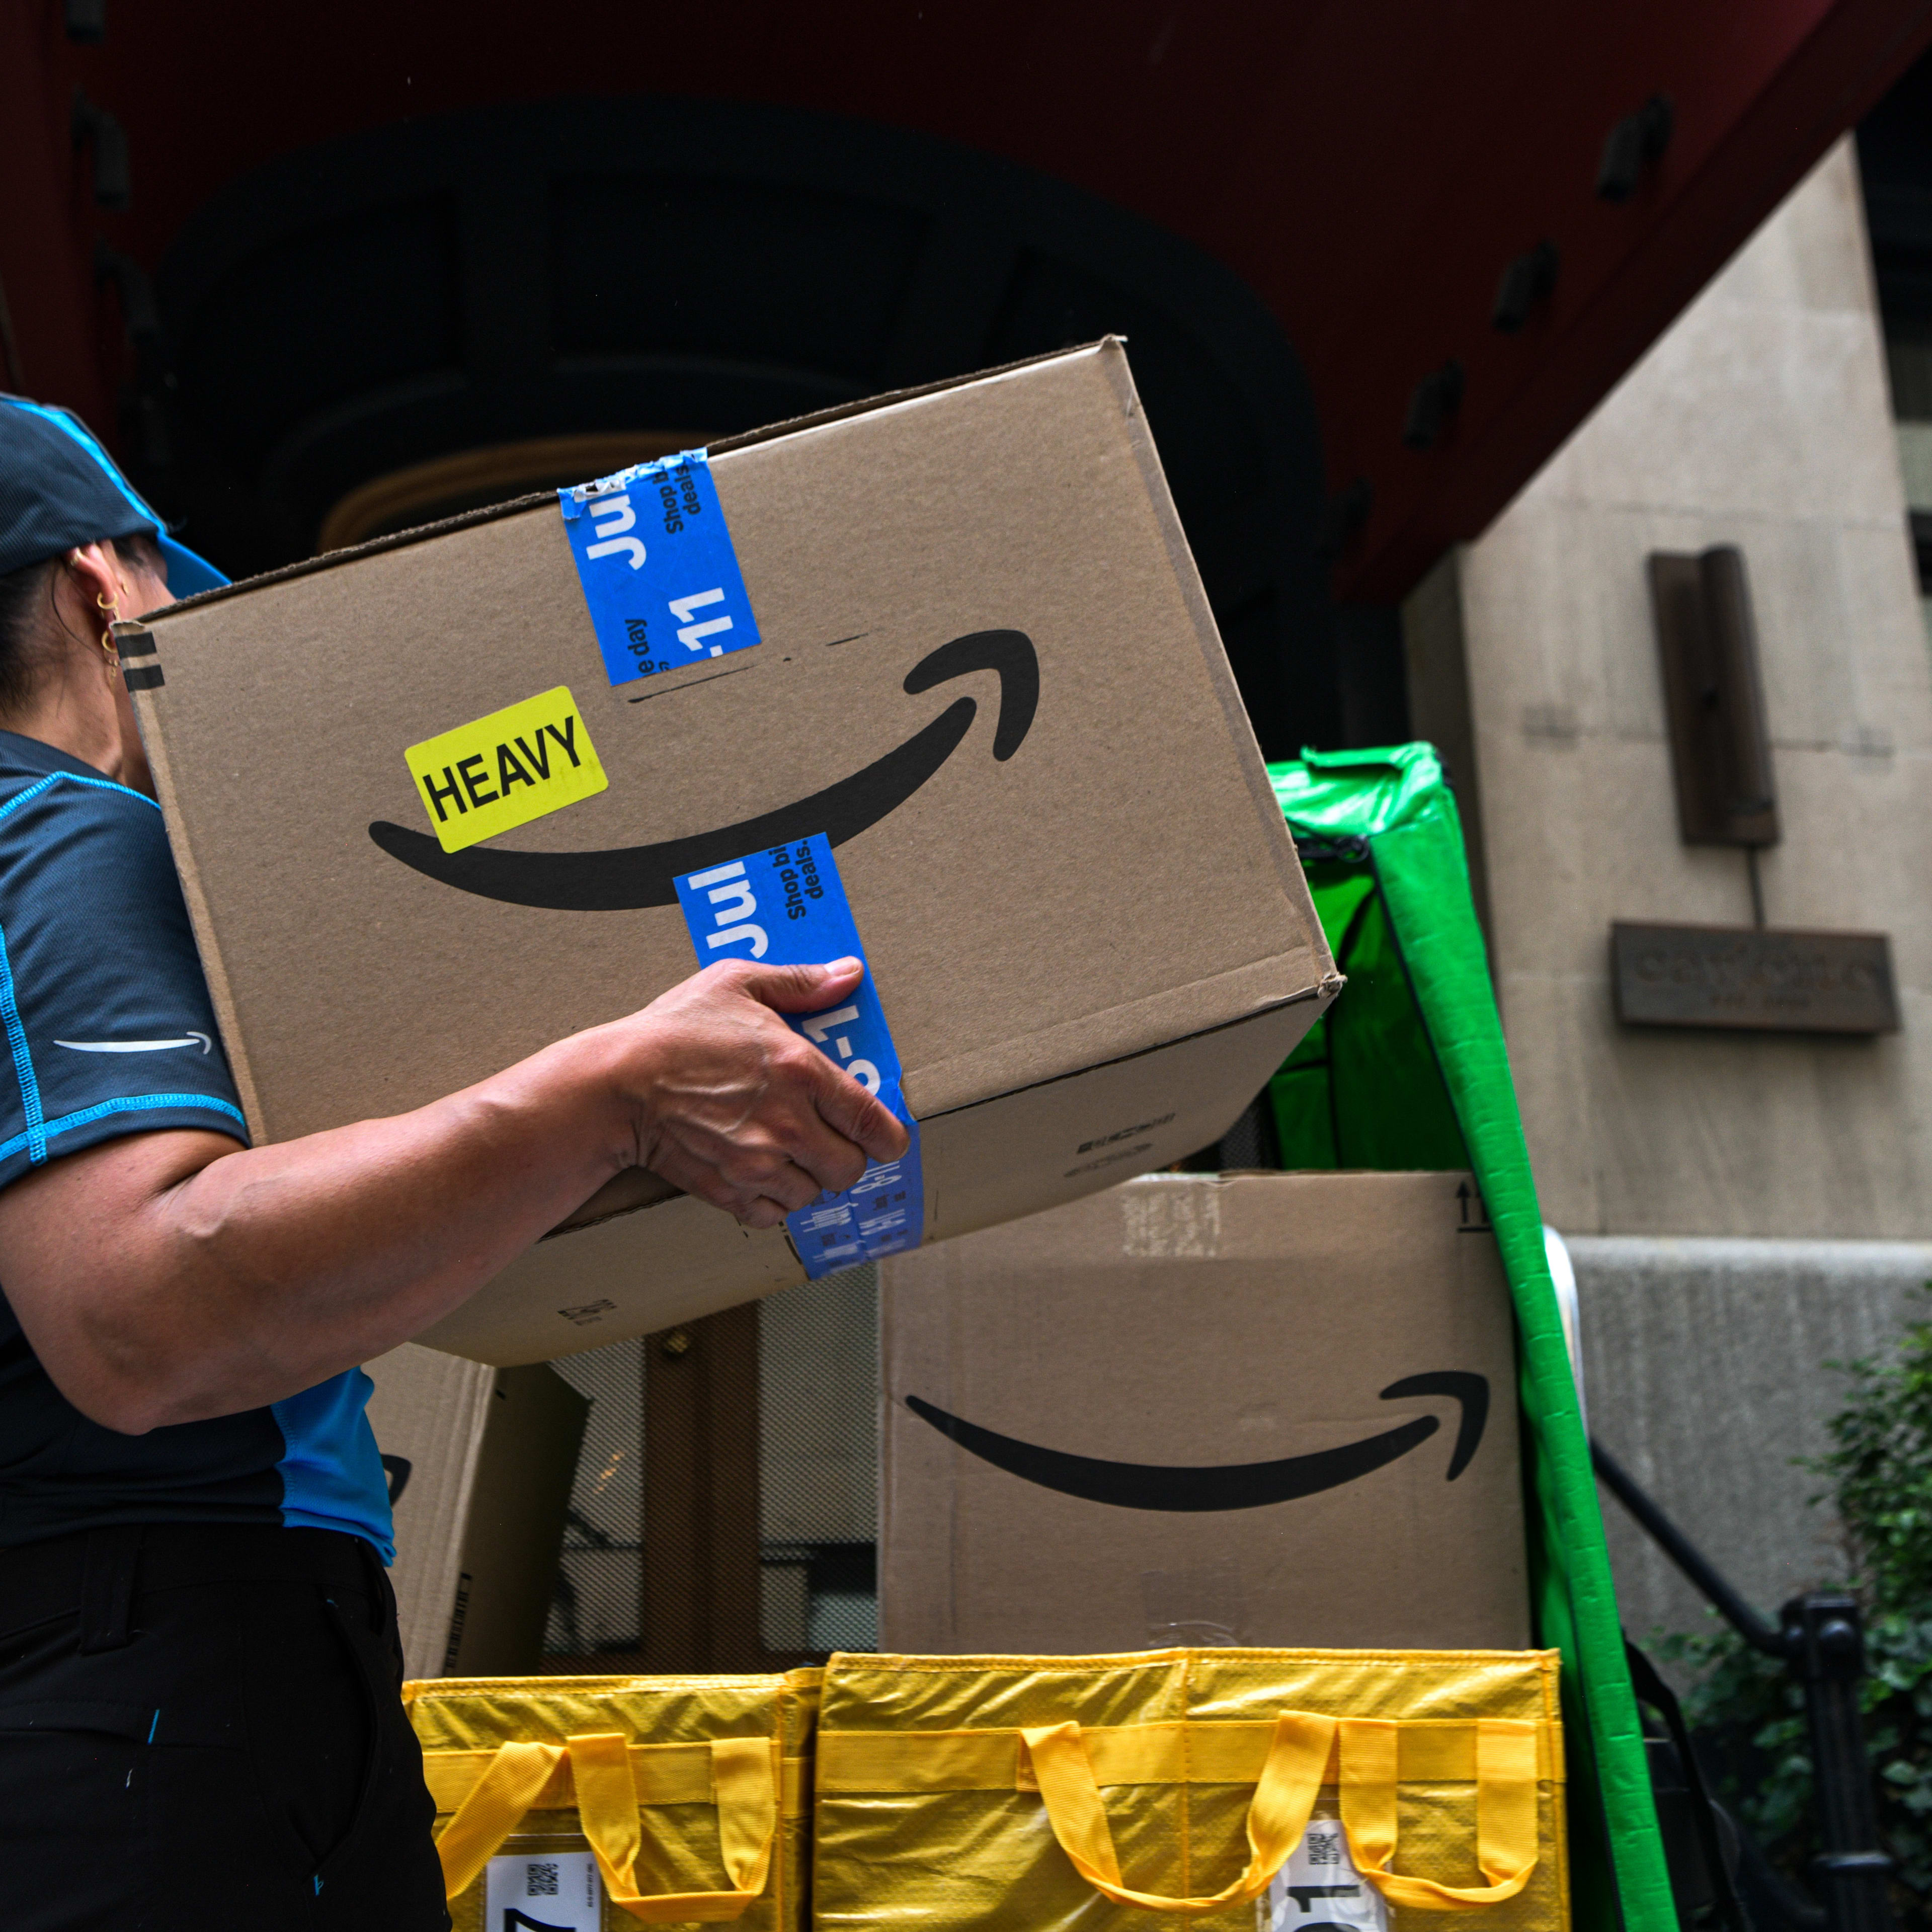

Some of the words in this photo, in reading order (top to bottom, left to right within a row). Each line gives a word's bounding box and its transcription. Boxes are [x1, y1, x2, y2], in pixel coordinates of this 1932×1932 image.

[660, 487, 683, 534] Shop
[624, 619, 647, 656] day
[423, 715, 581, 822] HEAVY
[780, 870, 806, 920] Shop
[796, 841, 823, 899] deals.
[688, 861, 768, 959] Jul
